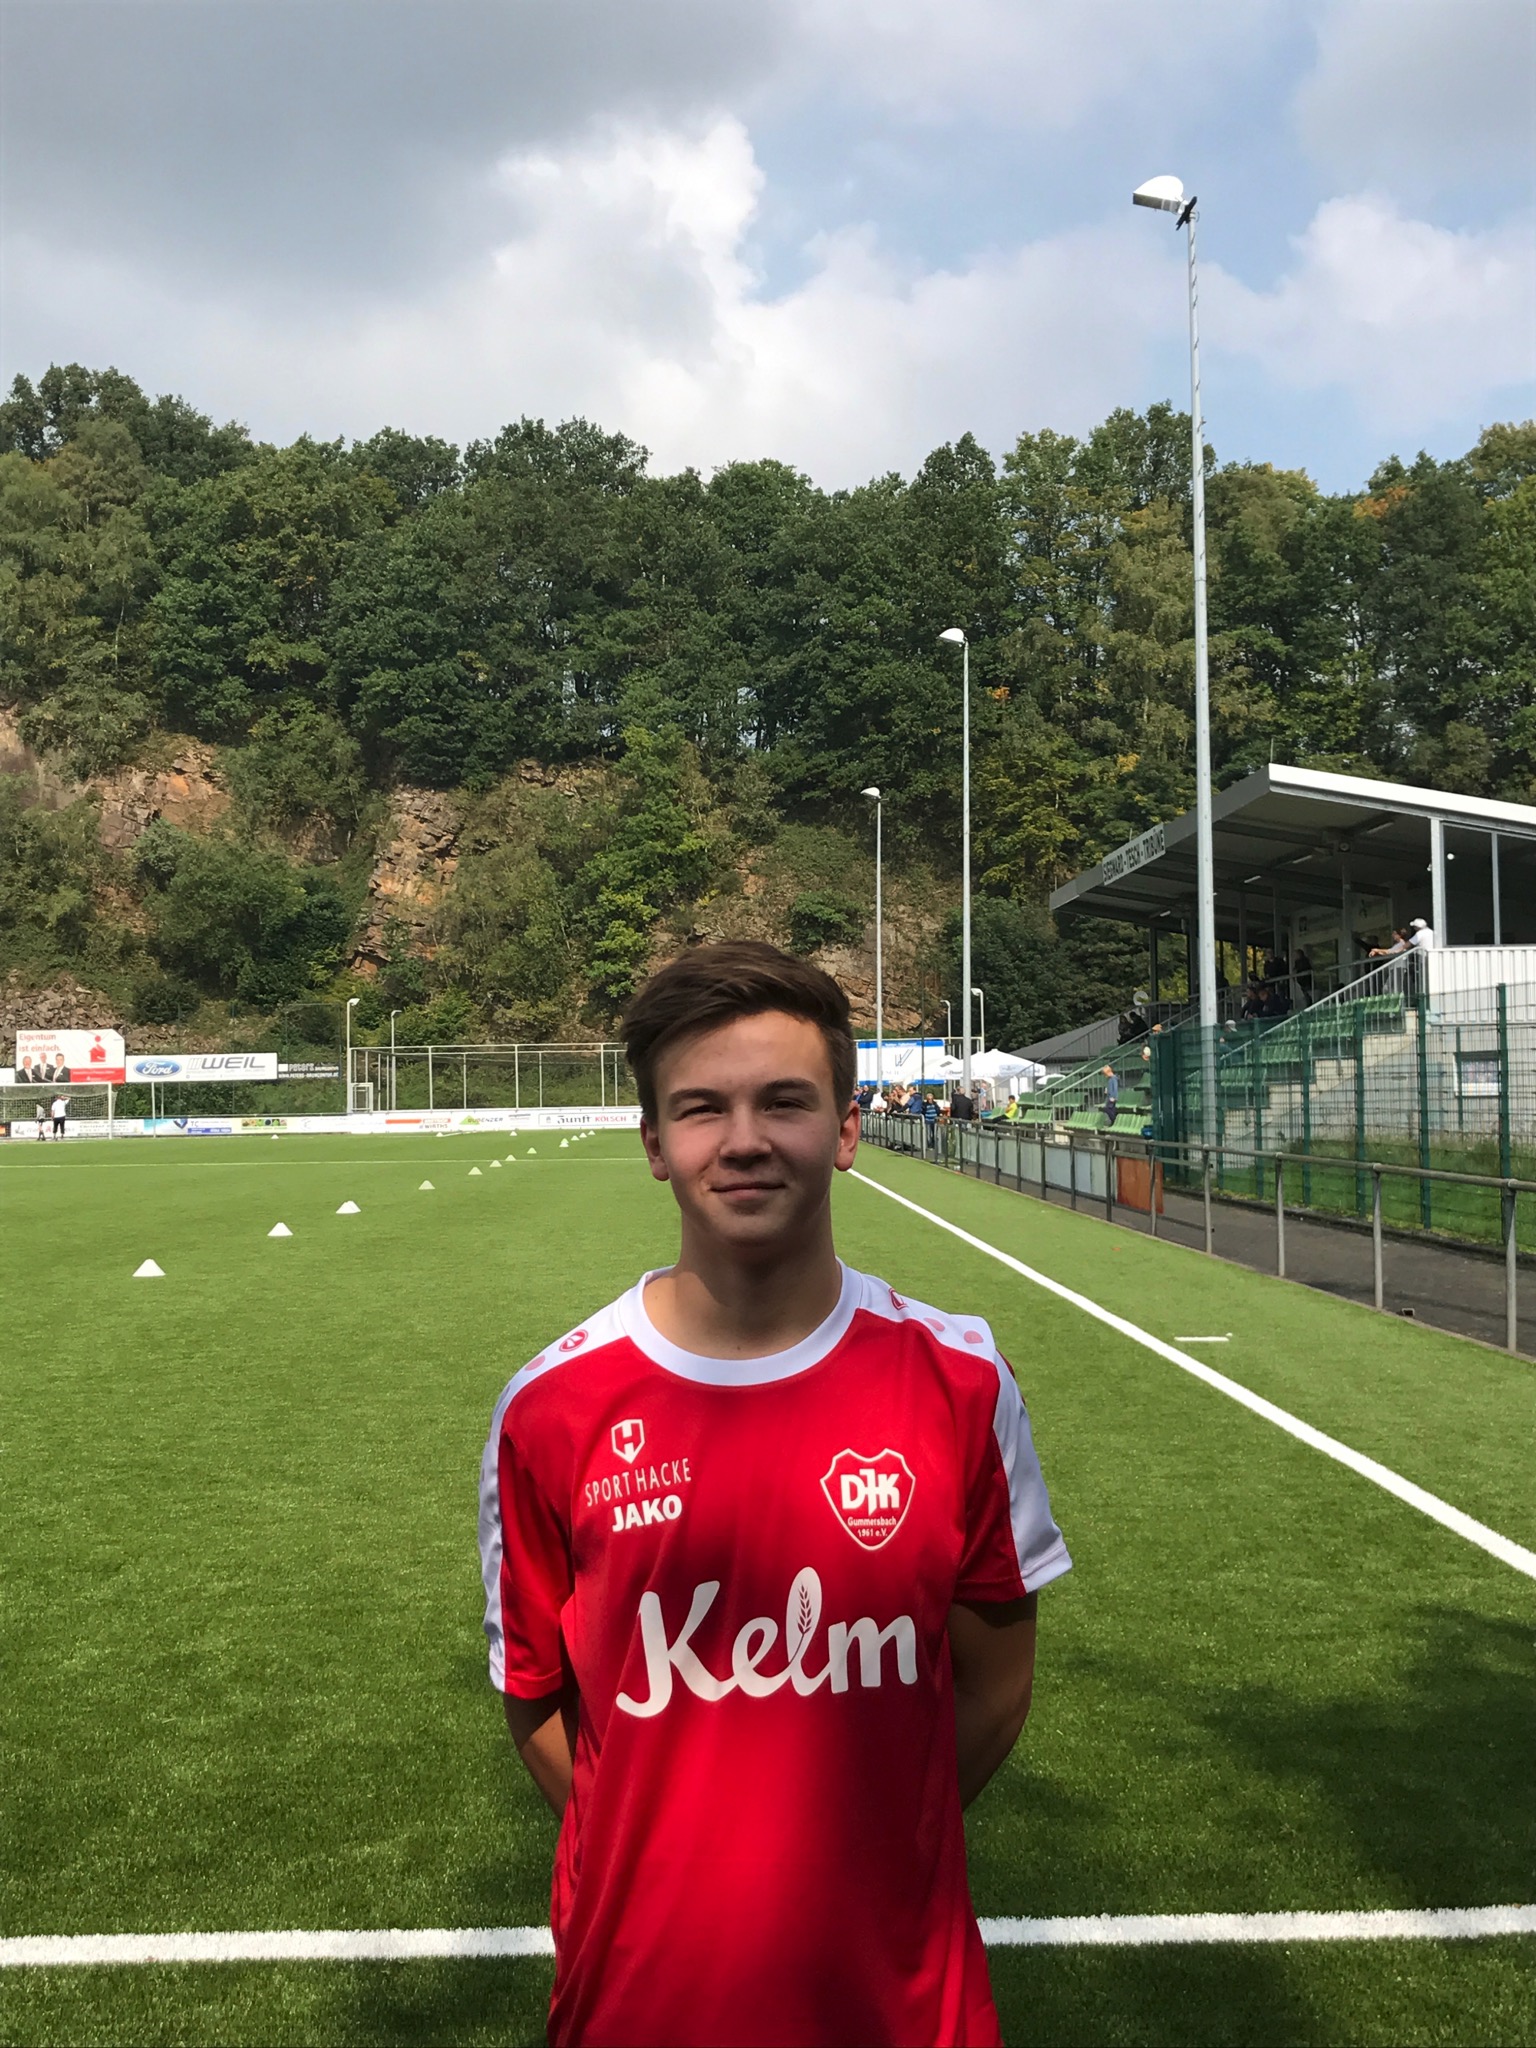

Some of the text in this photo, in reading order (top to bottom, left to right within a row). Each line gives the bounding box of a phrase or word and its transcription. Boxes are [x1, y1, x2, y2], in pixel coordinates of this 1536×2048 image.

[19, 1034, 56, 1042] Eigentum
[142, 1058, 173, 1075] Ford
[202, 1057, 265, 1069] WEIL
[612, 1494, 683, 1532] JAKO
[847, 1516, 897, 1527] Gummersbach
[857, 1528, 874, 1537] 1961
[616, 1566, 918, 1718] Kelm
